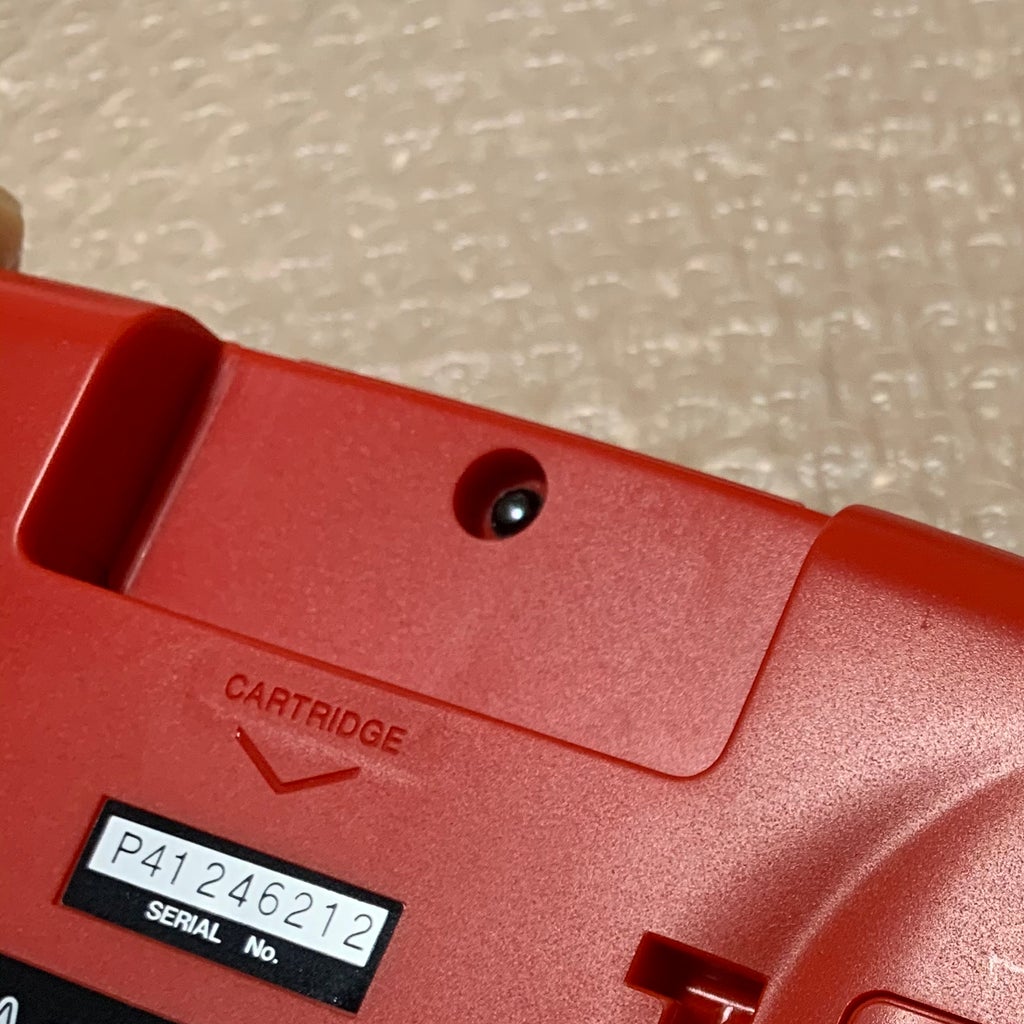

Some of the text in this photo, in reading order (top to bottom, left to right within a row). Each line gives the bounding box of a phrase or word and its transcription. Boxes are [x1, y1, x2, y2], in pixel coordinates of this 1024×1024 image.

[224, 673, 408, 756] CARTRIDGE
[111, 830, 374, 951] P41246212
[145, 900, 279, 964] SERIAL No.
